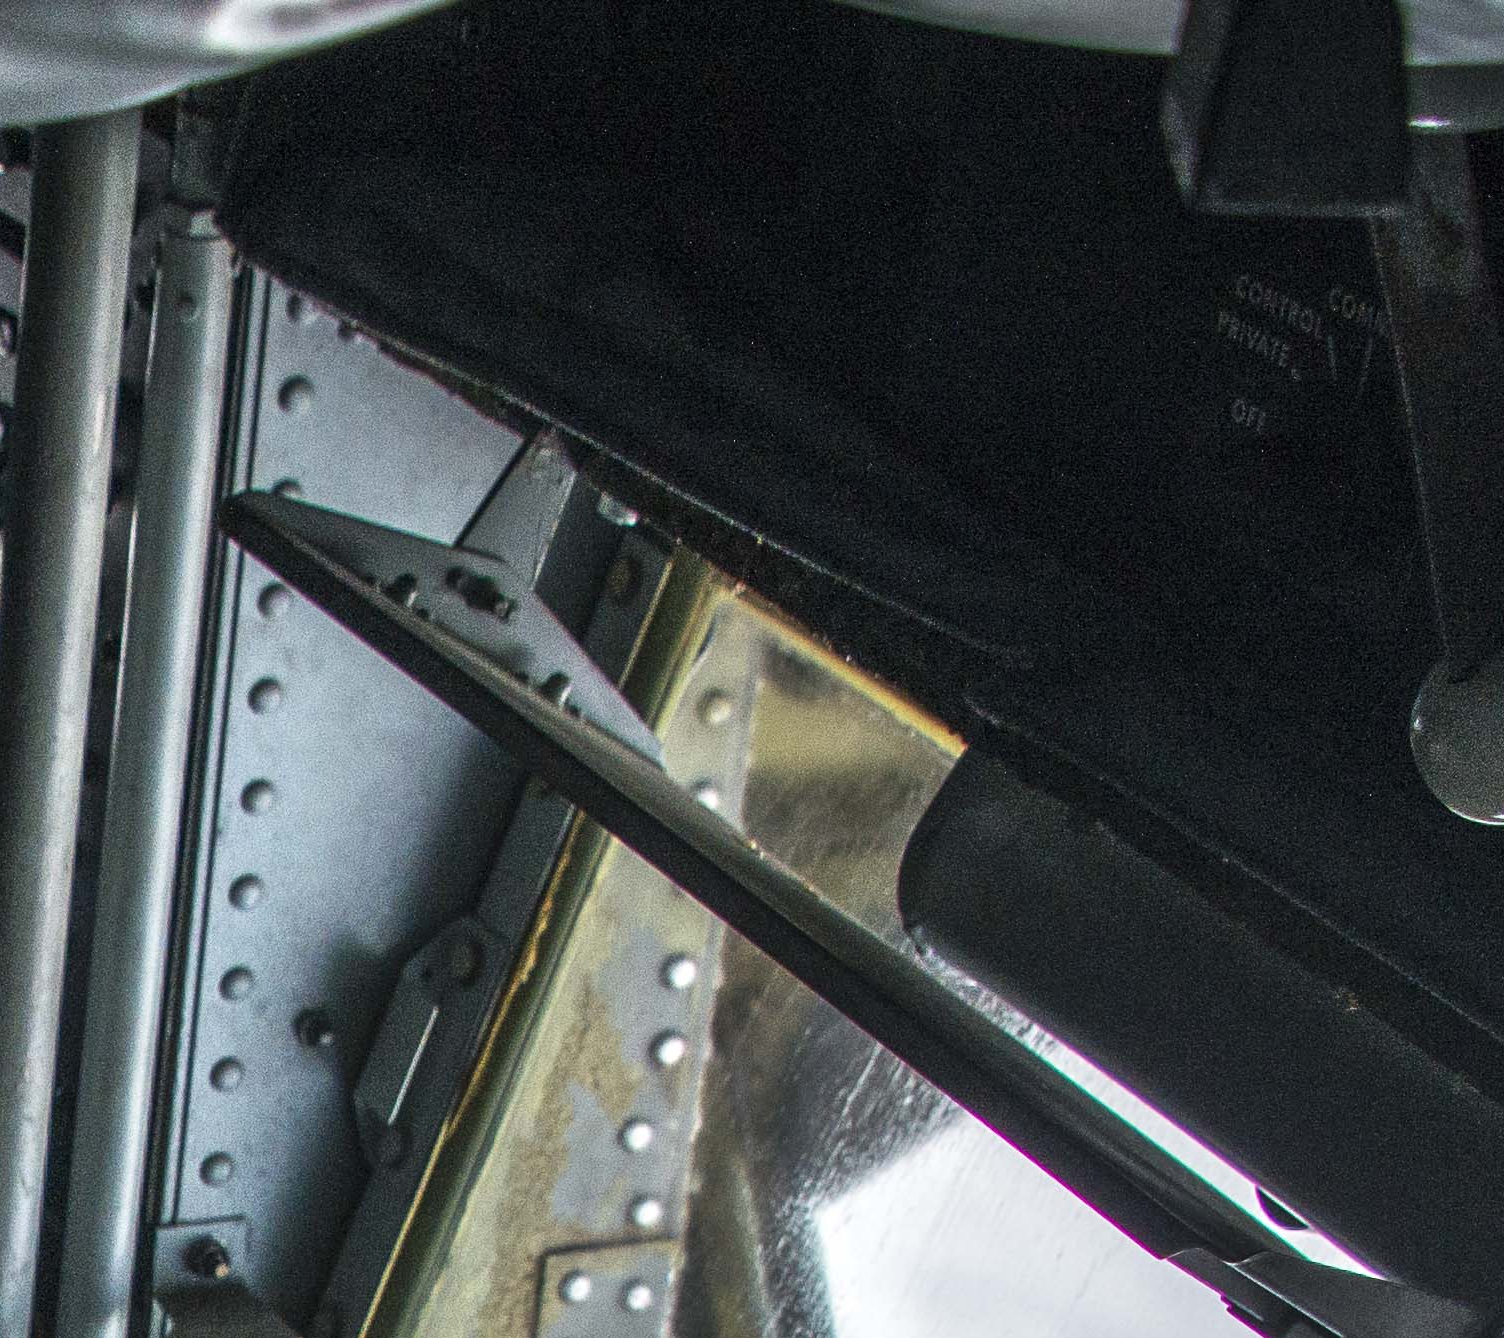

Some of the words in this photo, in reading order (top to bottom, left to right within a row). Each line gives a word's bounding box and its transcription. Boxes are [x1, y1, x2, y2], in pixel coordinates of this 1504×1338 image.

[1236, 275, 1324, 339] CONTROL
[1216, 309, 1296, 368] PRIVATE
[1229, 397, 1268, 435] OFF
